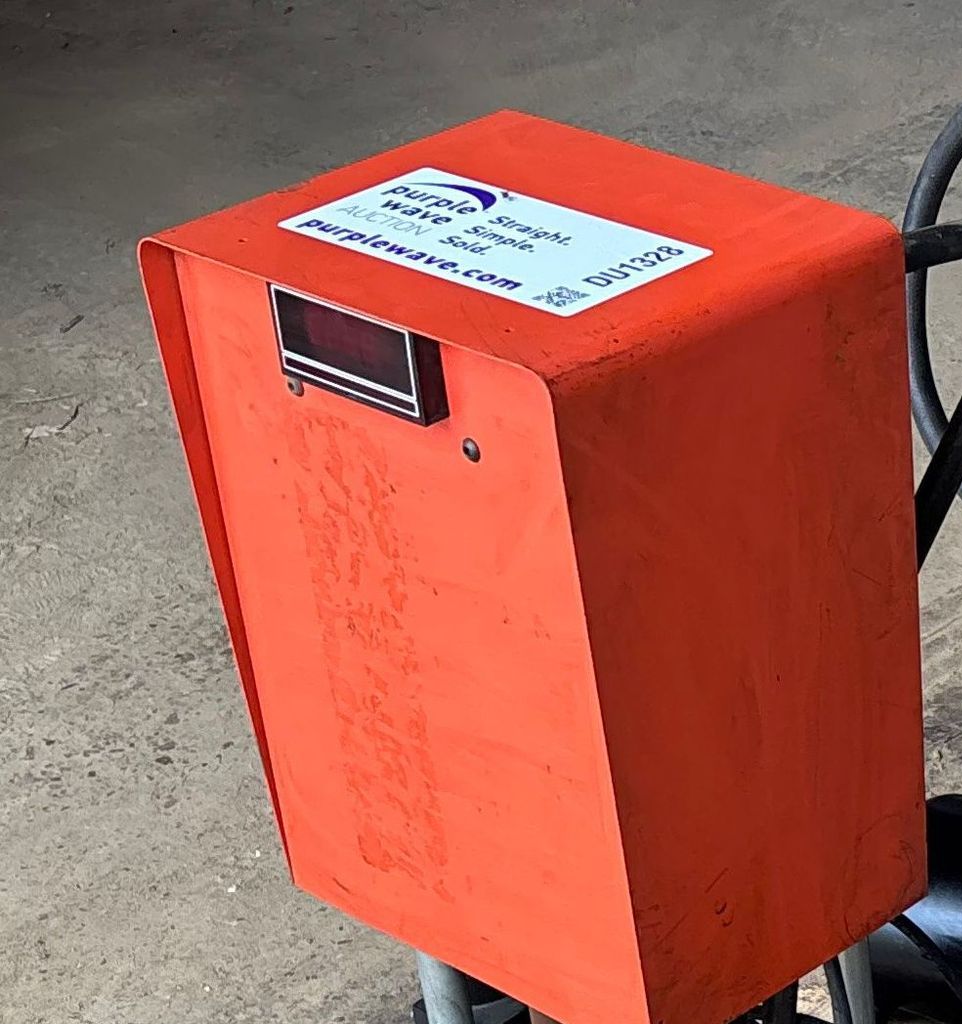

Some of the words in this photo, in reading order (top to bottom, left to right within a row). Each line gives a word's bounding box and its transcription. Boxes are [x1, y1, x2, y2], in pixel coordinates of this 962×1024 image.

[381, 185, 477, 215] purple
[381, 199, 453, 225] wave
[335, 205, 433, 236] AUCTION
[487, 215, 573, 246] Straight.
[438, 235, 492, 256] Sold.
[463, 225, 535, 253] Simple.
[295, 218, 523, 291] purplewave.com
[581, 245, 685, 288] DU1328
